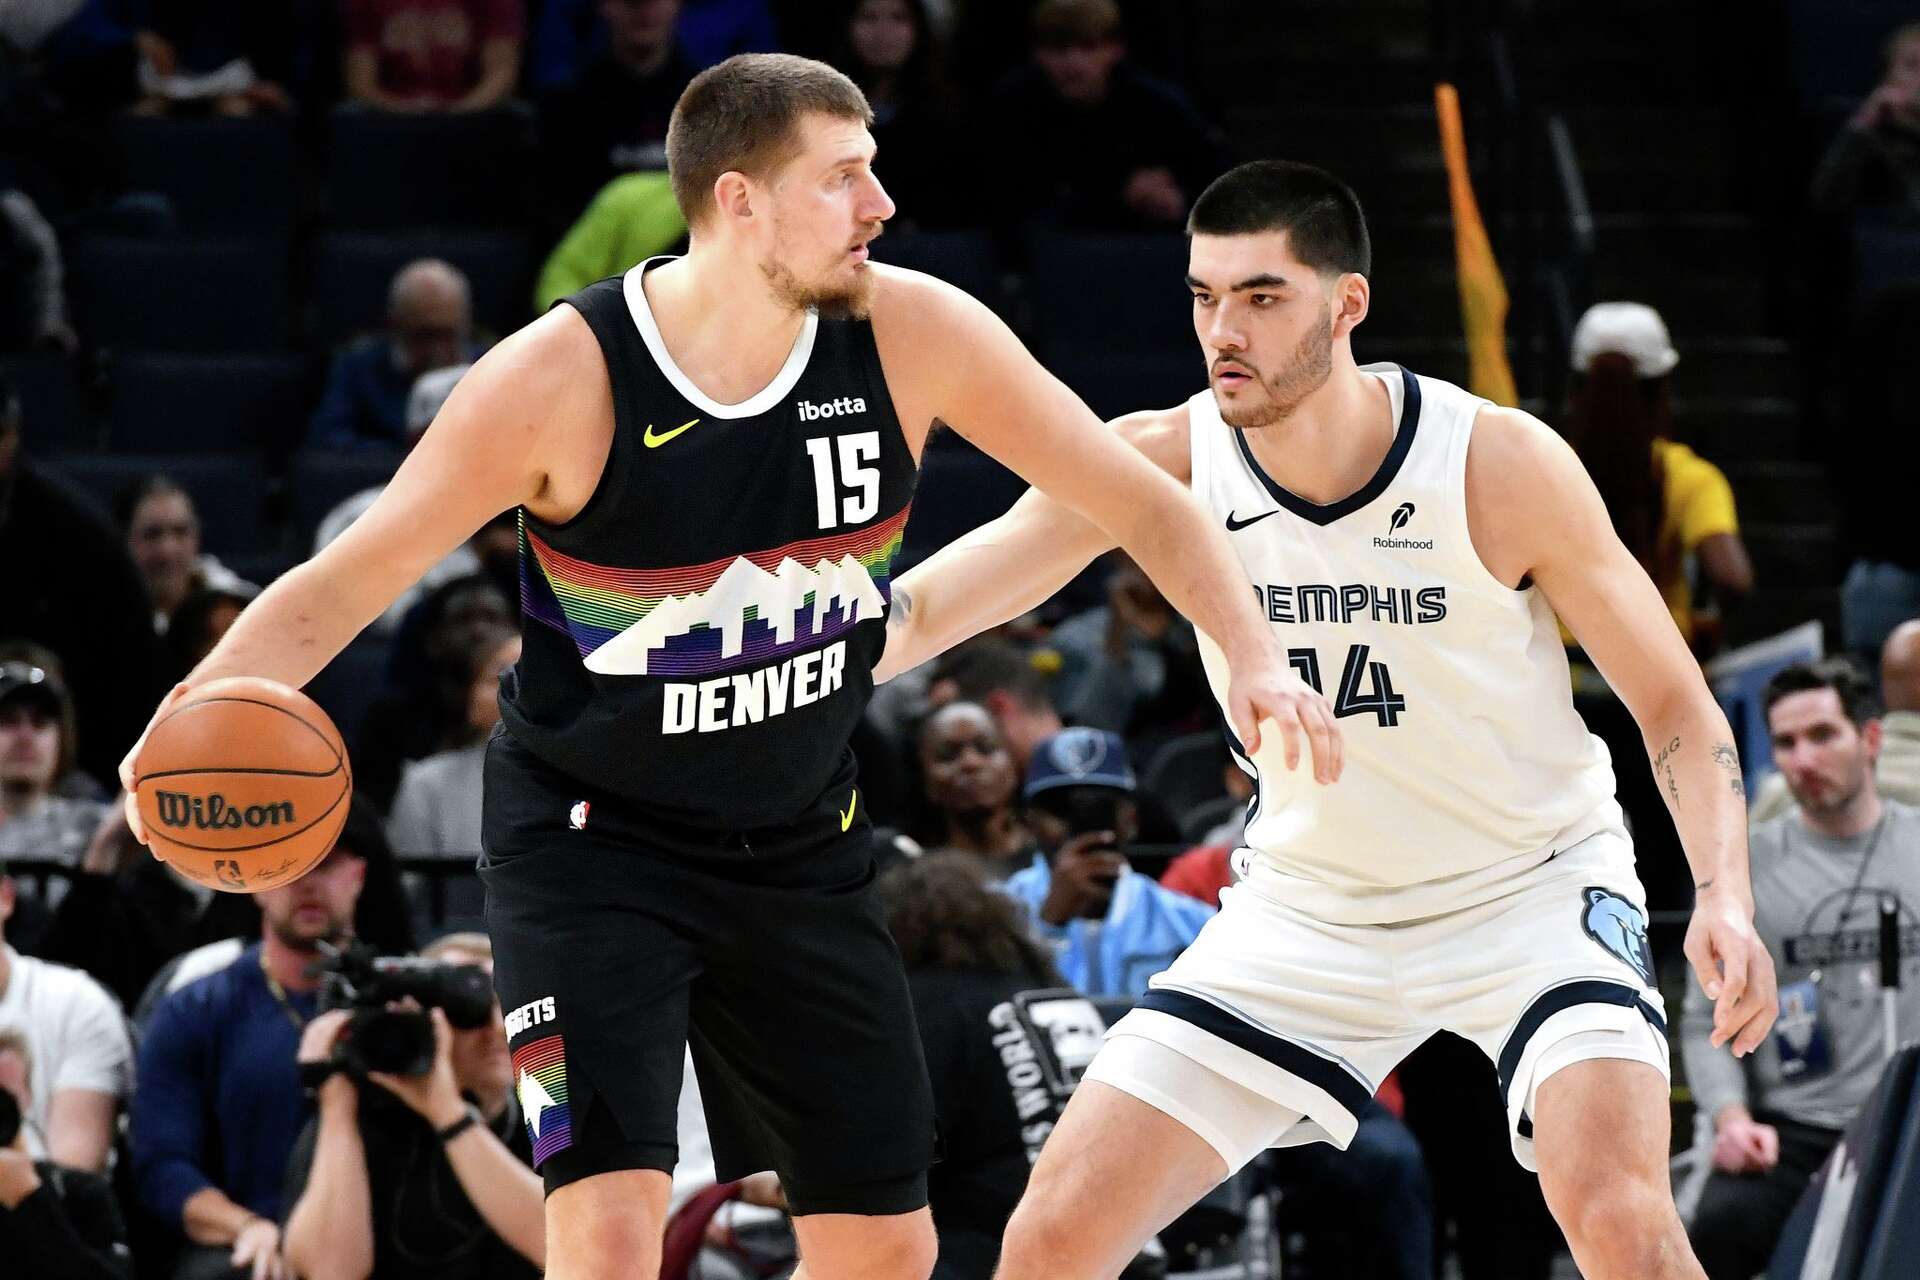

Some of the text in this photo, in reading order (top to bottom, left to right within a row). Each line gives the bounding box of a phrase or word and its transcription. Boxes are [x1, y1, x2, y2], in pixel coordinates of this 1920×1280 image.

[797, 397, 867, 421] ibotta
[805, 430, 880, 529] 15
[1373, 537, 1433, 550] Robinhood
[1252, 584, 1447, 625] EMPHIS
[662, 640, 847, 735] DENVER
[1287, 644, 1406, 728] 14
[155, 789, 296, 830] Wilson
